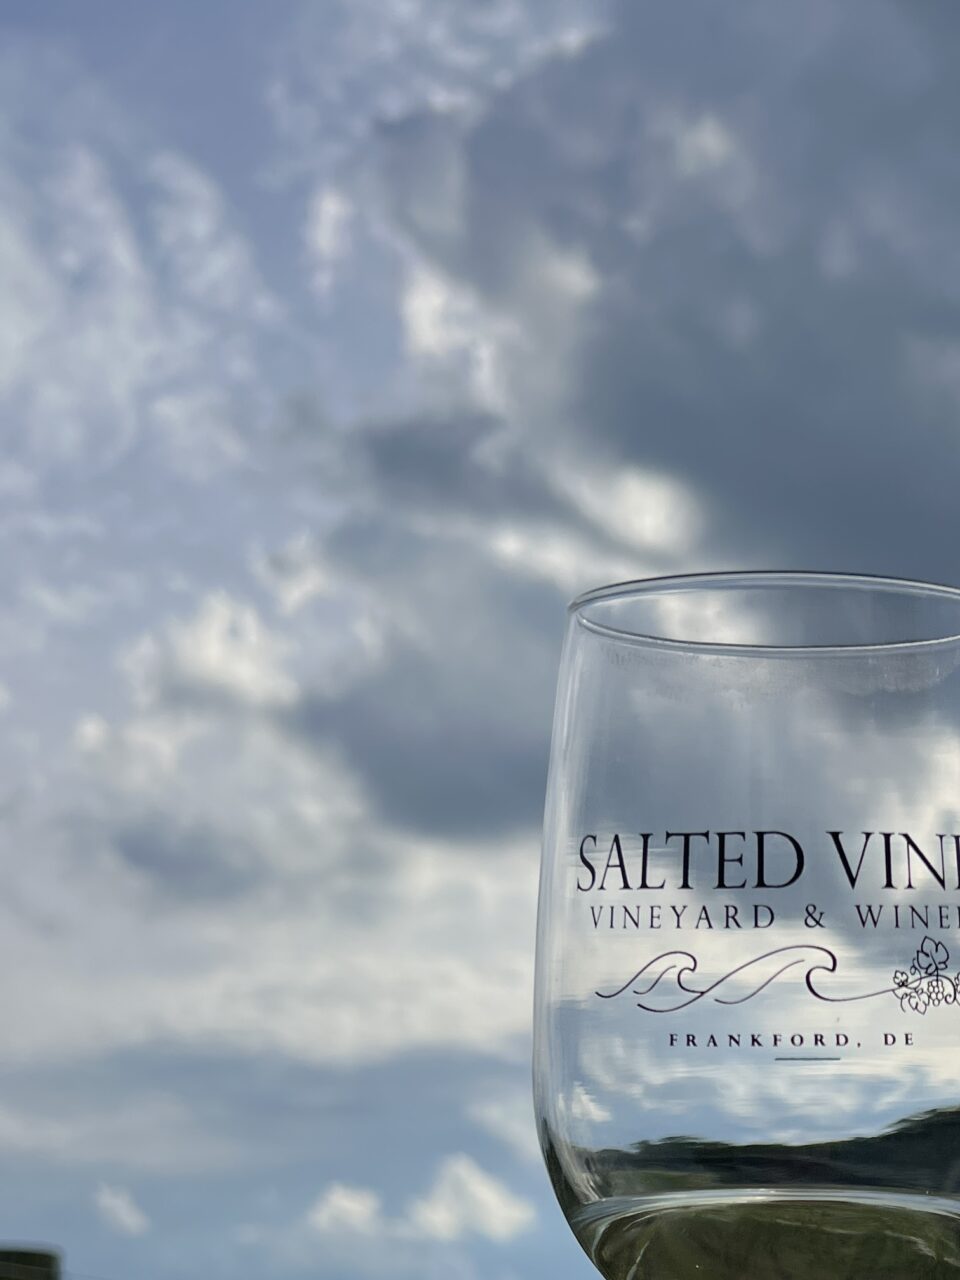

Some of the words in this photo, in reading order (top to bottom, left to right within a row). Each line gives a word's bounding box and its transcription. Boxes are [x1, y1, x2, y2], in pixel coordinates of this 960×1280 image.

[576, 830, 805, 892] SALTED
[590, 904, 775, 929] VINEYARD
[804, 903, 825, 929] &
[669, 1032, 862, 1049] FRANKFORD,
[883, 1032, 915, 1047] DE
